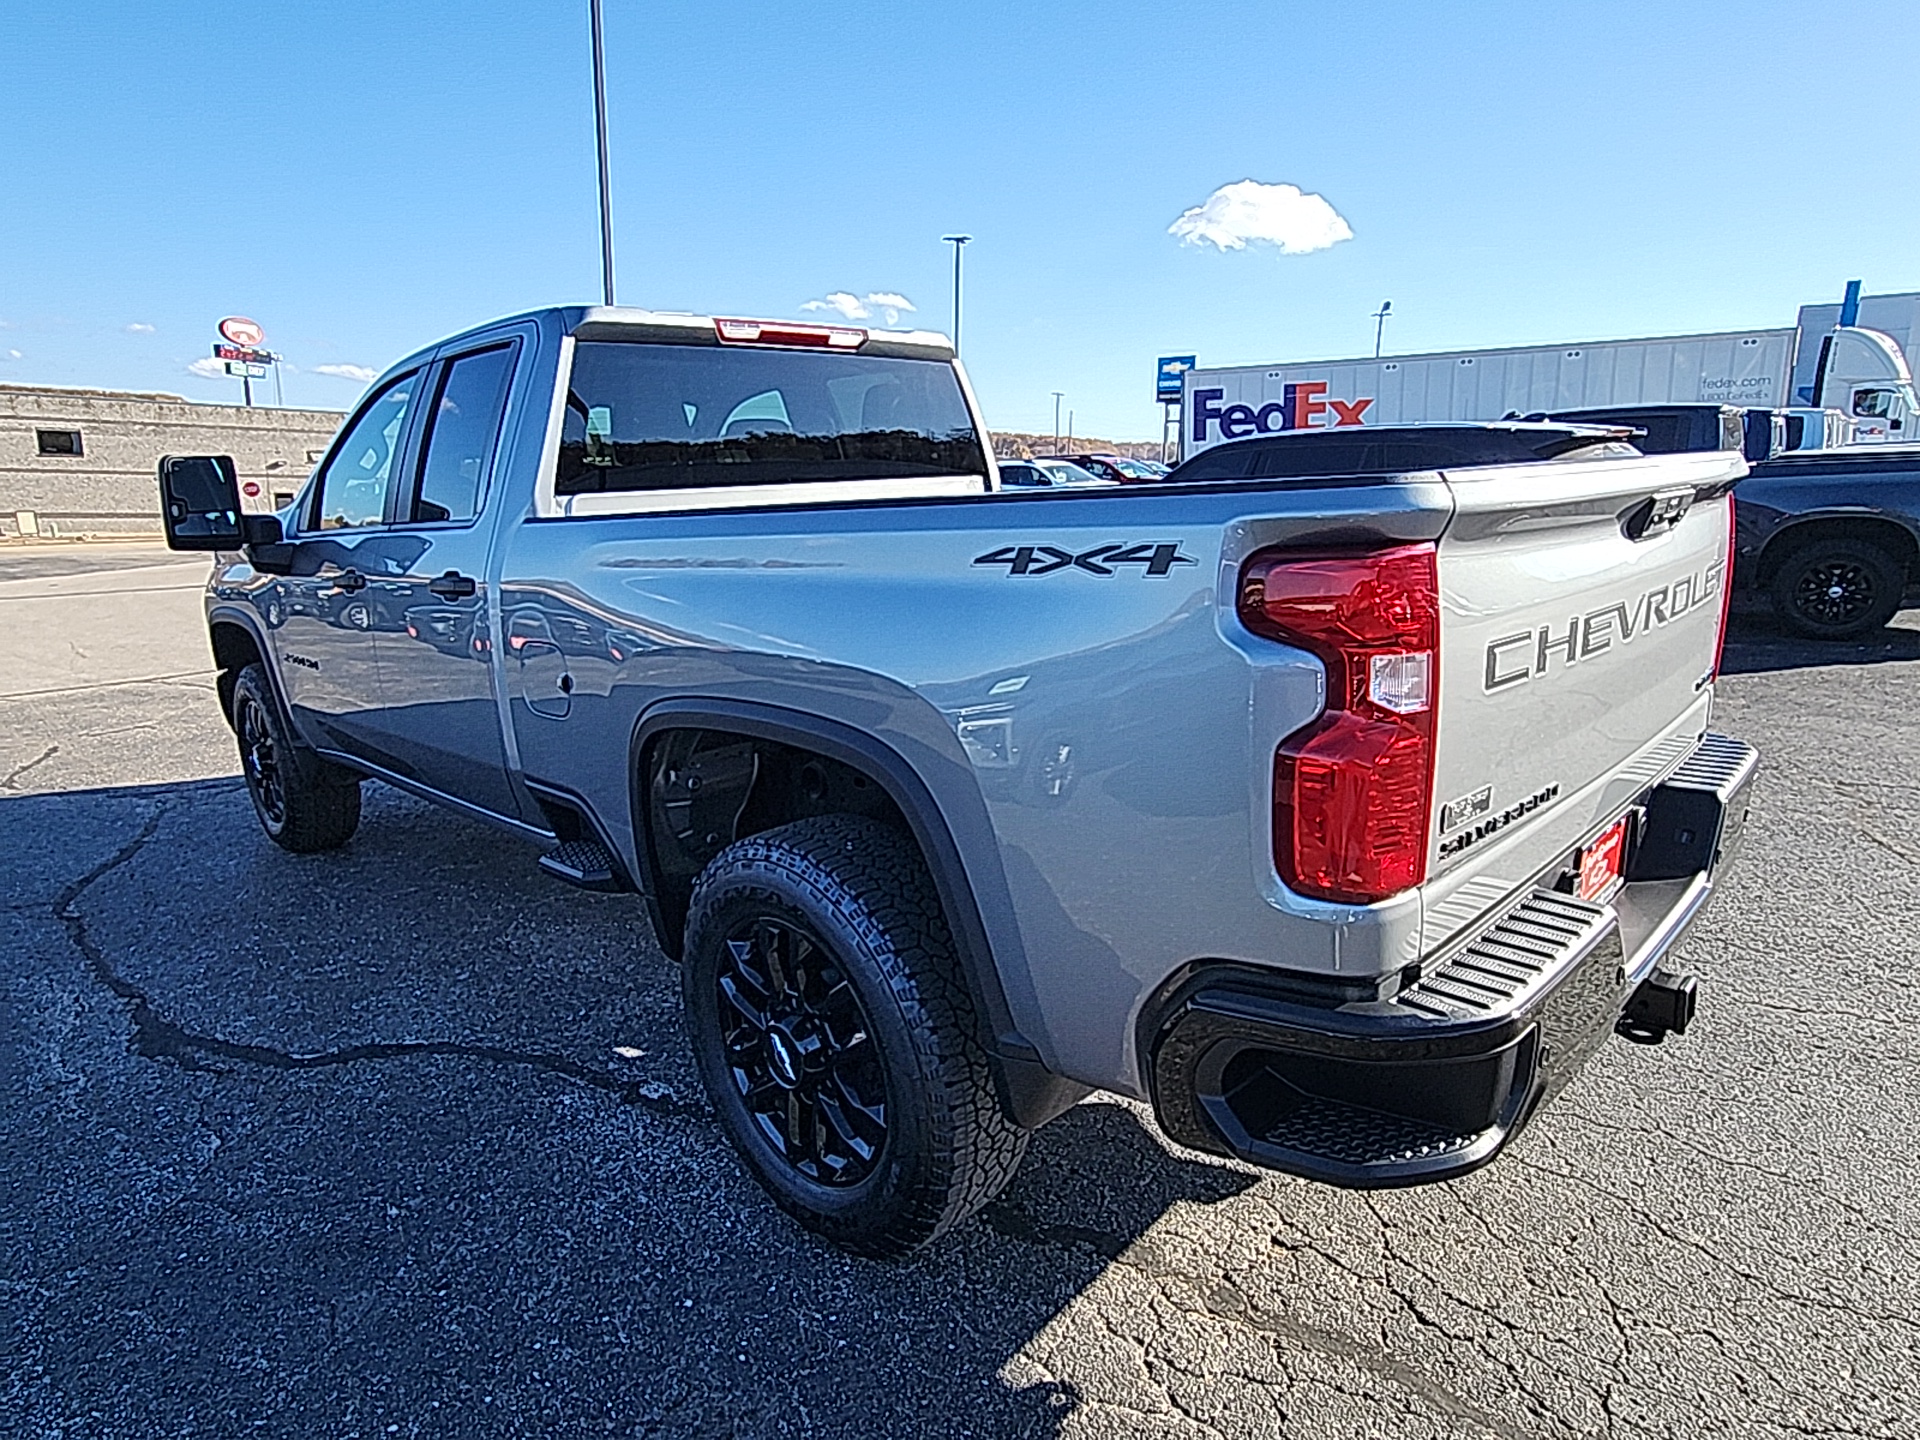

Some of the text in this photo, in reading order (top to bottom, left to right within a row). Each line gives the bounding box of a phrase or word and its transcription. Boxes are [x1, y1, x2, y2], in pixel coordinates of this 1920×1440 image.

[1193, 381, 1375, 441] FedEx
[1702, 377, 1771, 389] fedex.com
[1484, 558, 1725, 692] CHEVROLET
